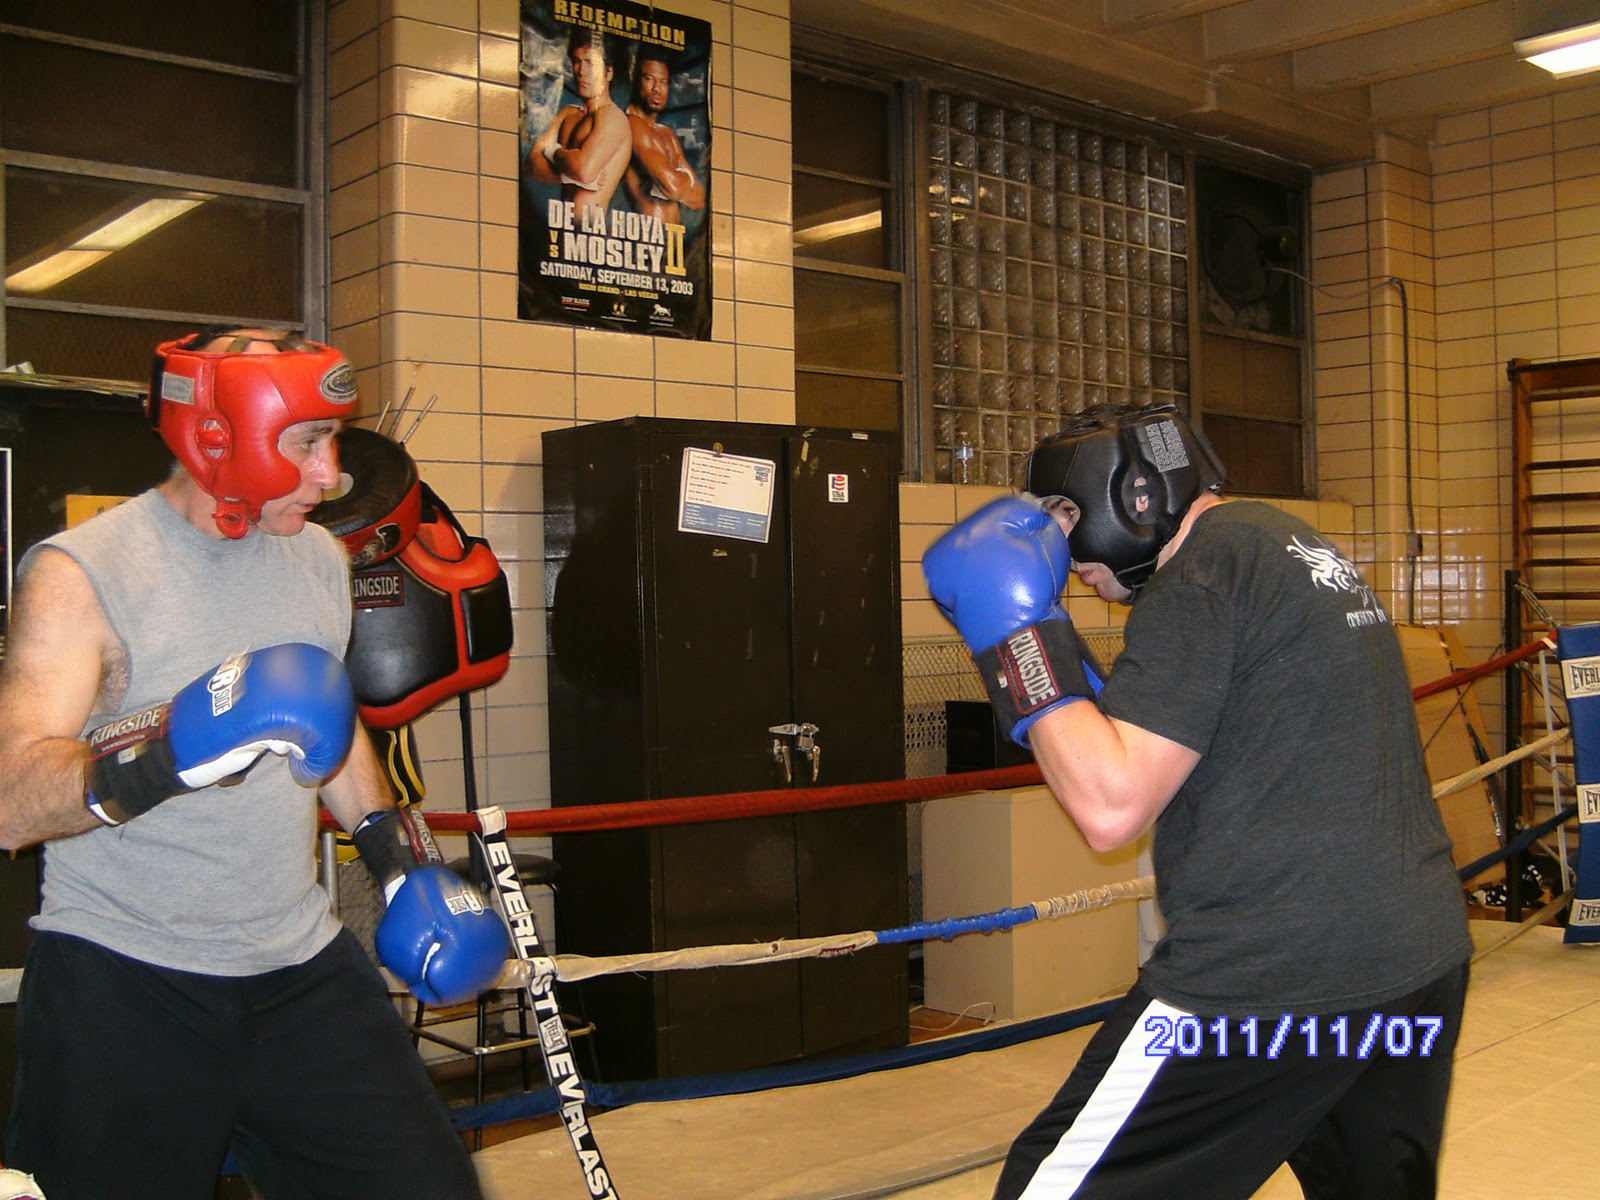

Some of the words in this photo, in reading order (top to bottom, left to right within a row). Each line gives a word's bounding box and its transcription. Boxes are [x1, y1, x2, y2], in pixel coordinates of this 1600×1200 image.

[554, 0, 685, 45] REDEMPTION
[548, 199, 575, 231] DE
[581, 204, 606, 235] LA
[611, 209, 665, 245] HOYA
[563, 232, 664, 273] MOSLEY
[540, 261, 596, 284] SATURDAY,
[597, 268, 653, 290] SEPTEMBER
[671, 279, 694, 296] 2003
[353, 576, 400, 597] INGSIDE
[1007, 631, 1057, 706] RINGSIDE
[91, 709, 161, 748] RINGSIDE
[487, 842, 559, 1015] EVERLAST
